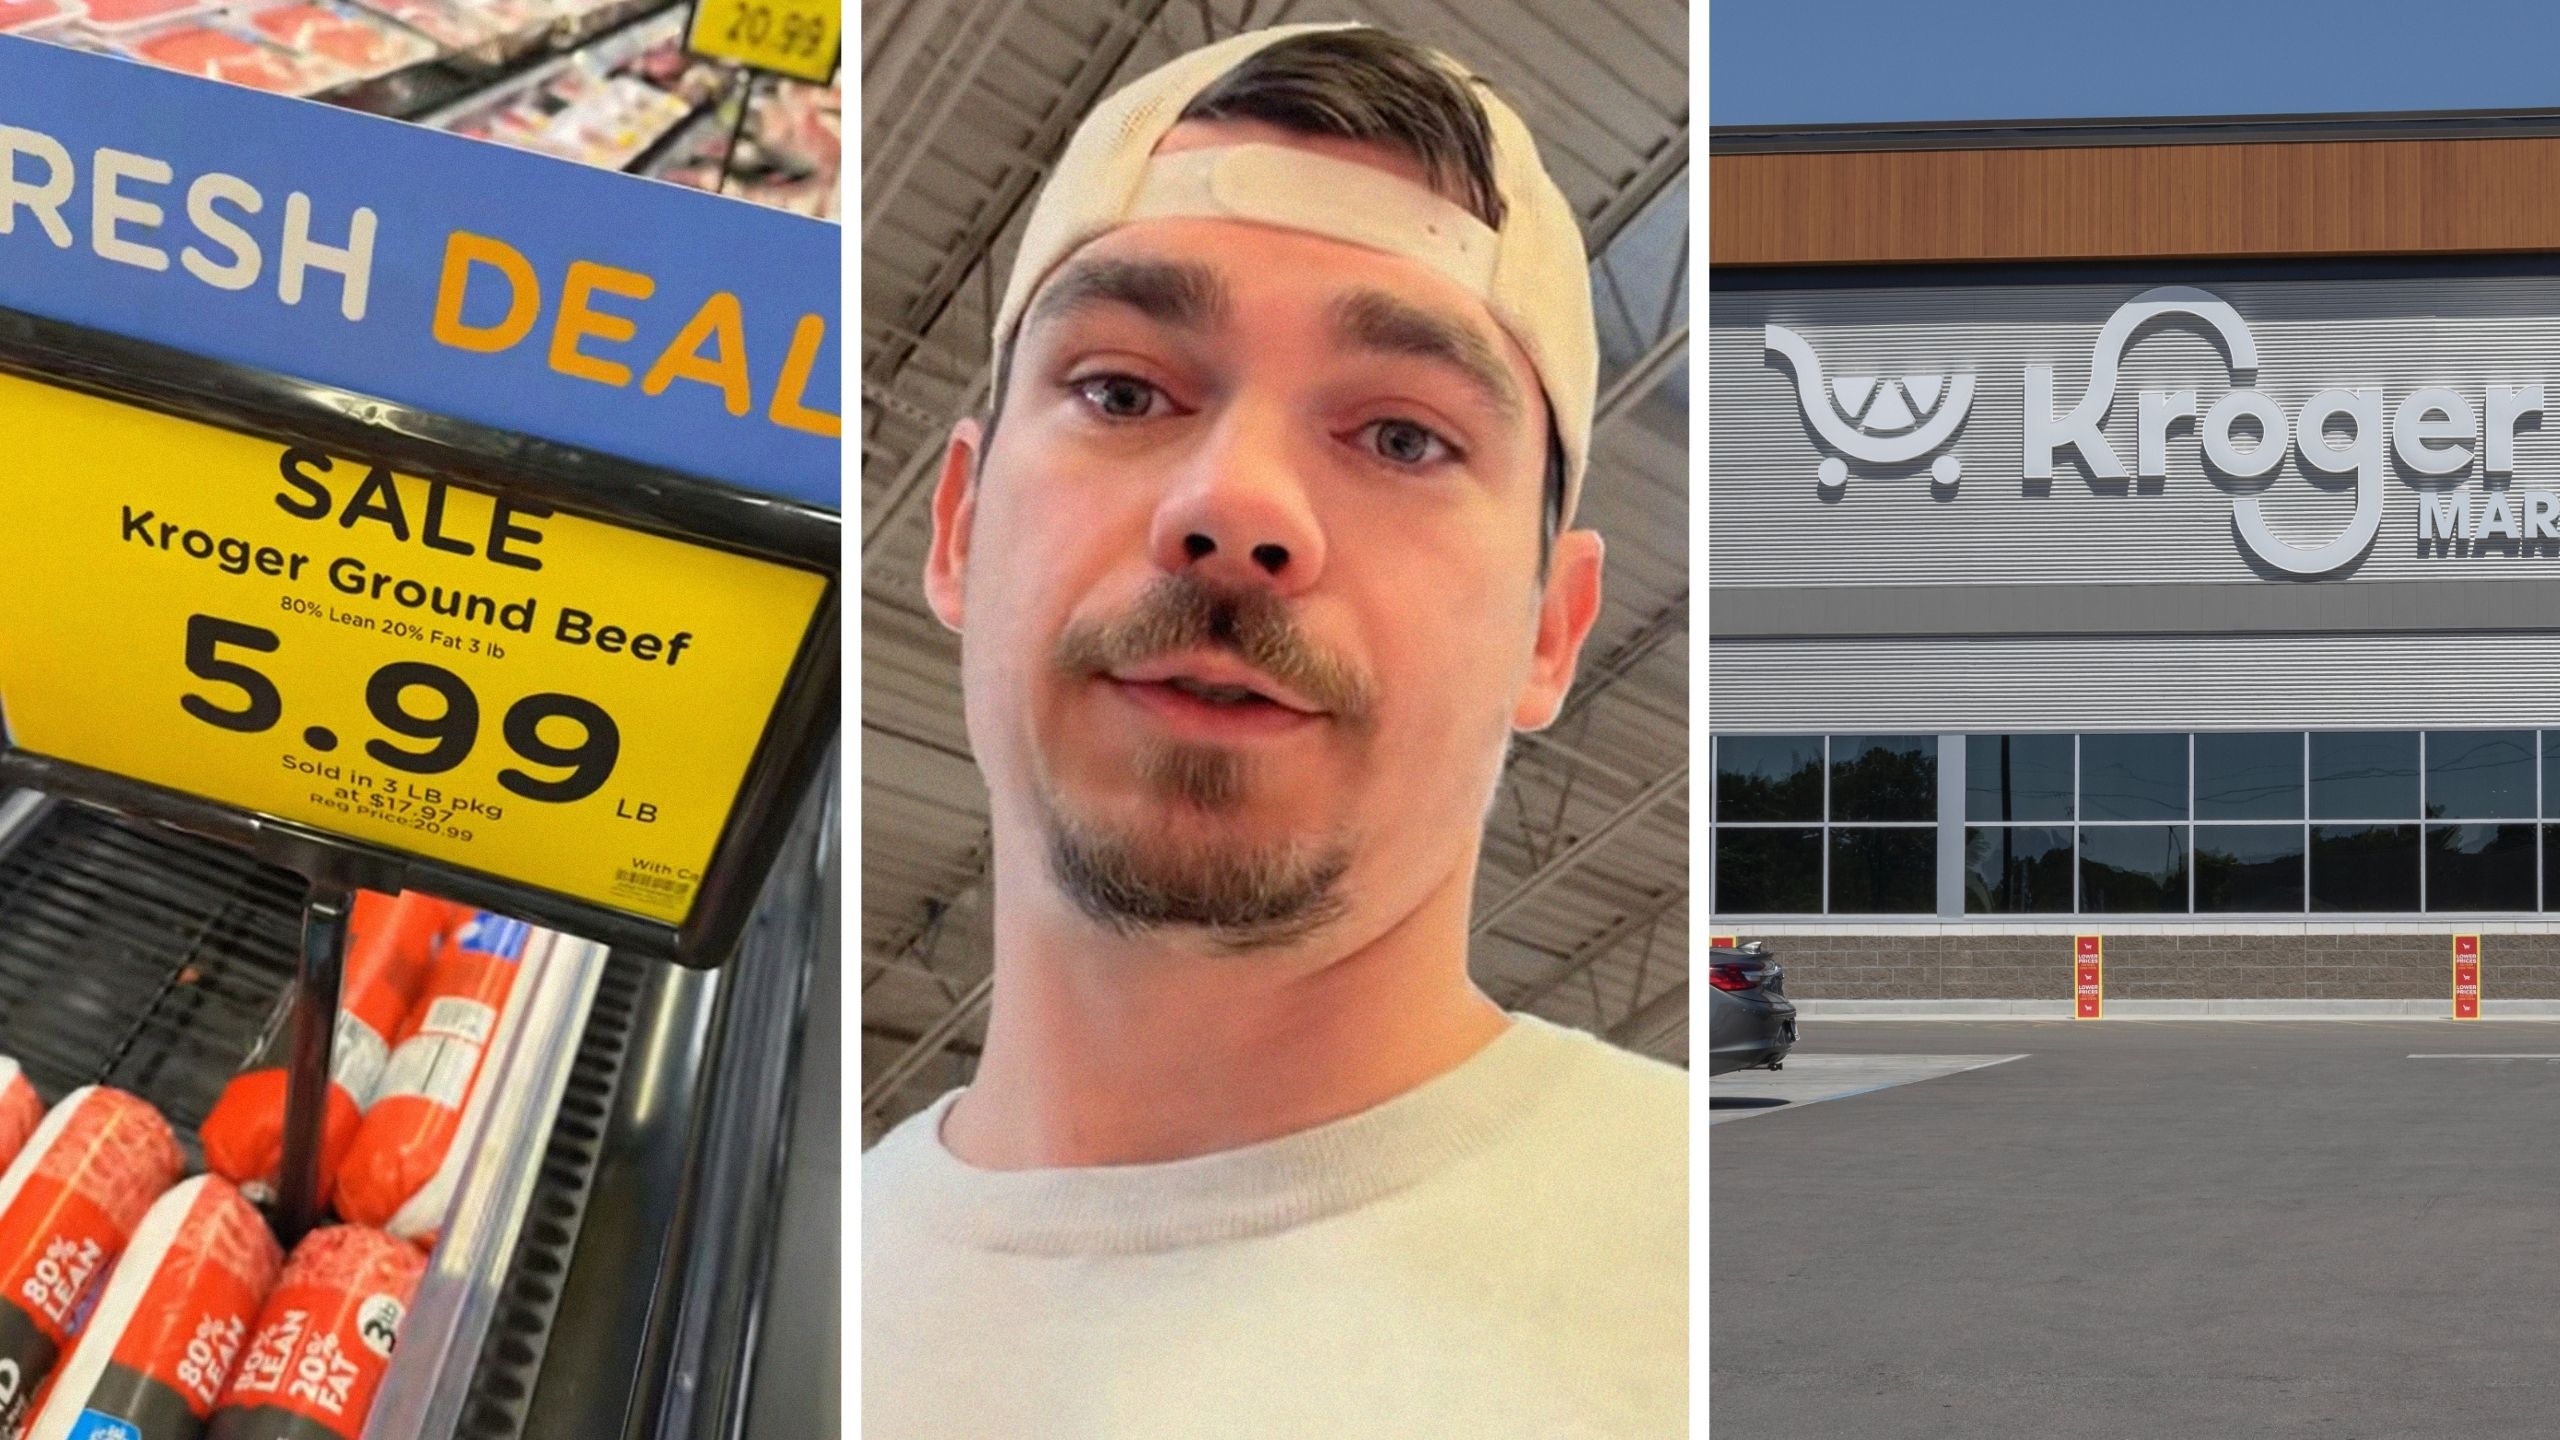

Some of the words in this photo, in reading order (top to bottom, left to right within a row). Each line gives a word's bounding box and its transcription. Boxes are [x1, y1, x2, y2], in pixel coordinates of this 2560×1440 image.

[727, 1, 825, 58] 20.99
[0, 124, 379, 322] RESH
[432, 230, 842, 439] DEAL
[2023, 286, 2544, 574] Kroger
[275, 447, 554, 572] SALE
[2420, 490, 2560, 539] MAR
[122, 505, 309, 580] Kroger
[328, 557, 537, 634] Ground
[555, 607, 693, 666] Beef
[281, 595, 322, 618] 80%
[329, 607, 375, 630] Lean
[381, 619, 423, 641] 20%
[430, 629, 463, 650] Fat
[468, 638, 480, 653] 3
[486, 642, 505, 660] lb
[180, 613, 620, 803] 5.99
[282, 754, 341, 781] Sold
[350, 770, 373, 789] in
[383, 778, 397, 793] 3
[407, 784, 442, 804] LB
[451, 796, 503, 821] pkg
[309, 793, 349, 813] Reg
[335, 787, 360, 802] at
[370, 792, 453, 824] $17.97
[616, 798, 657, 823] LB
[632, 857, 672, 875] With
[22, 1233, 79, 1308] 80%
[177, 1311, 225, 1389] 80%
[197, 1312, 246, 1405] LEAN
[253, 1309, 309, 1393] LEAN
[287, 1331, 339, 1403] 20%
[316, 1349, 360, 1417] FAT
